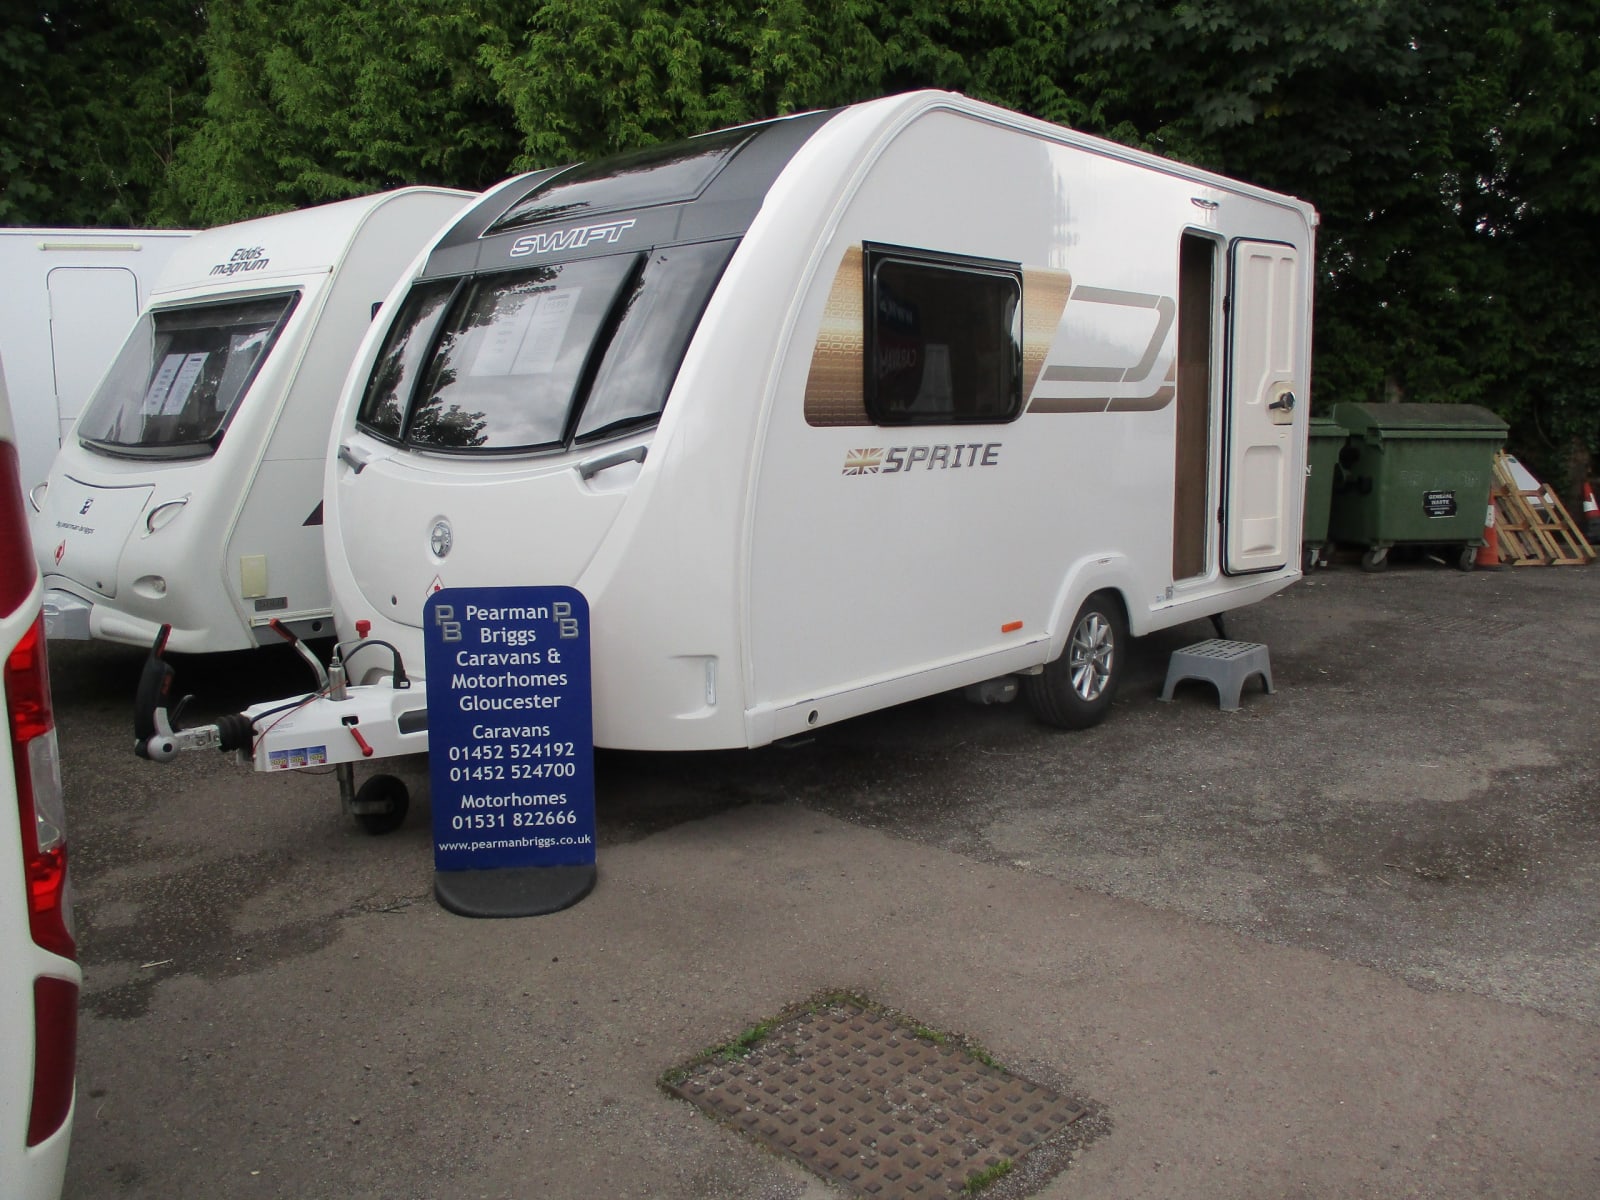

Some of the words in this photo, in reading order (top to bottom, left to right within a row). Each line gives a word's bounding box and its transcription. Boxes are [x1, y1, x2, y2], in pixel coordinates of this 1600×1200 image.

[510, 218, 636, 257] SWIFT
[230, 247, 265, 261] Elddis
[209, 259, 269, 276] magnum
[881, 443, 1002, 473] SPRITE
[467, 605, 548, 621] Pearman
[481, 627, 536, 646] Briggs
[457, 651, 540, 666] Caravans
[548, 648, 561, 664] &
[452, 672, 567, 689] Motorhomes
[460, 695, 561, 711] Gloucester
[473, 725, 550, 739] Caravans
[450, 745, 504, 761] 01452
[511, 742, 575, 758] 524192
[450, 766, 505, 781] 01452
[512, 763, 575, 778] 524700
[461, 793, 567, 809] Motorhomes
[453, 814, 505, 829] 01531
[513, 810, 577, 826] 822666
[439, 834, 591, 851] www.pearmanbriggs.co.uk
